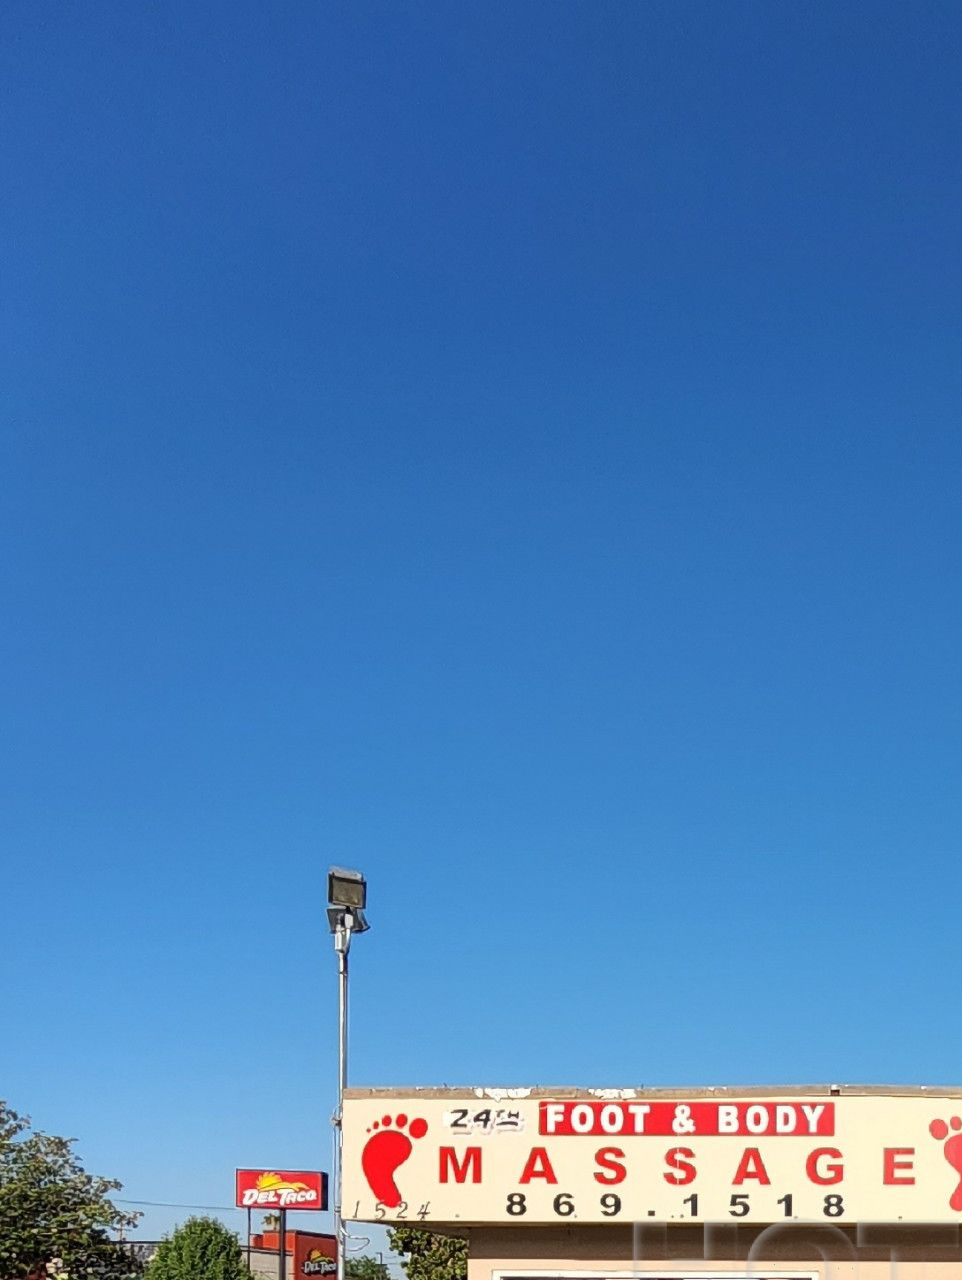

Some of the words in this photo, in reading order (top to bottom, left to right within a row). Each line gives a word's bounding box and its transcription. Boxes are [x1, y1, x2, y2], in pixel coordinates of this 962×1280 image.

[546, 1103, 651, 1134] FOOT
[671, 1104, 696, 1134] &
[717, 1104, 825, 1134] BODY
[438, 1145, 917, 1186] MASSAGE
[351, 1199, 431, 1221] 1524
[505, 1191, 846, 1218] 869.1518
